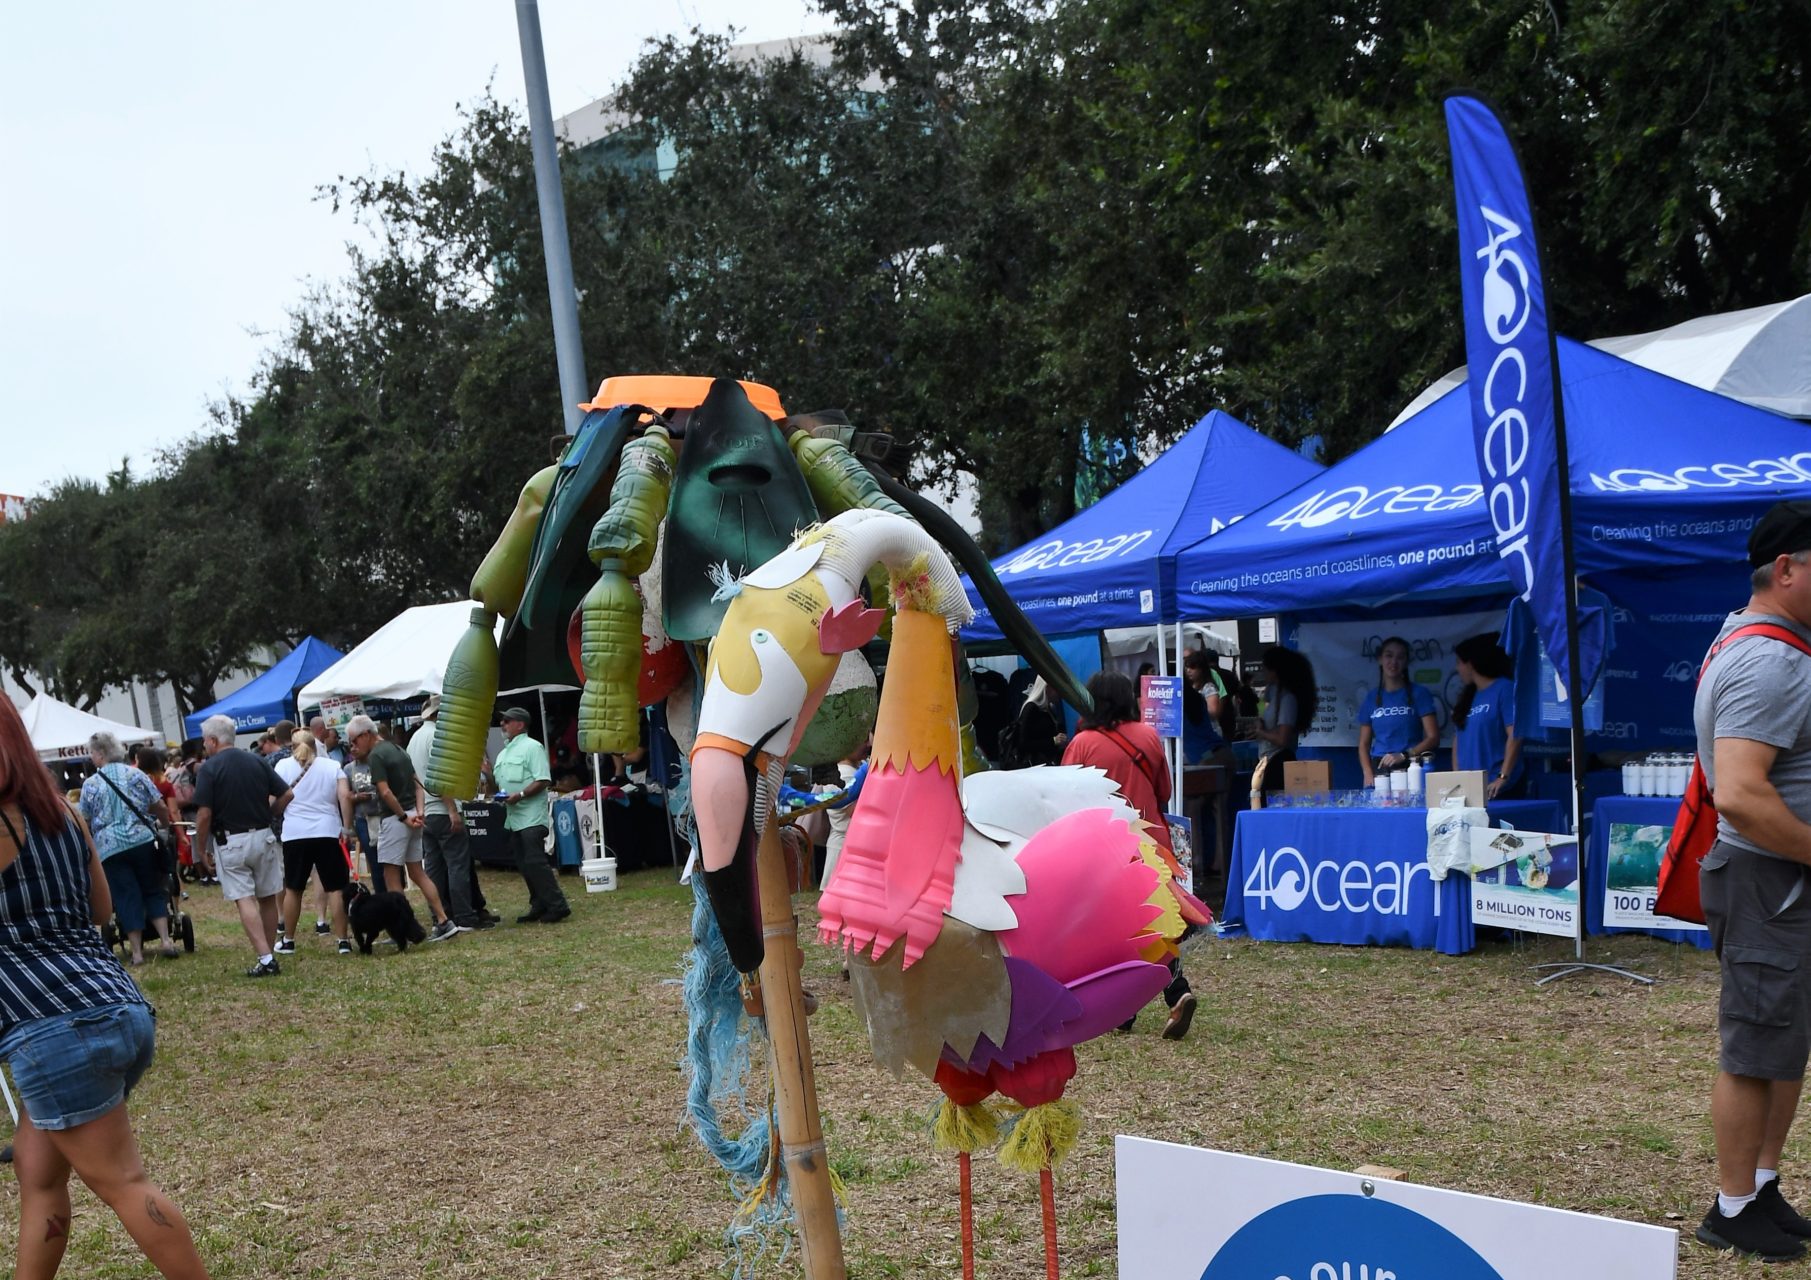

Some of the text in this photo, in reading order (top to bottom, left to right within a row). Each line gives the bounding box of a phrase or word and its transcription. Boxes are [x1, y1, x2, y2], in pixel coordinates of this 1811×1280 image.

[1592, 514, 1754, 541] Cleaning the oceans and
[1190, 577, 1239, 595] Cleaning
[1241, 573, 1259, 587] the
[1261, 566, 1303, 584] oceans
[1305, 560, 1329, 578] and
[1331, 554, 1396, 574] coastlines,
[1398, 551, 1425, 566] one
[1427, 540, 1475, 565] pound
[1057, 597, 1073, 607] one
[1073, 589, 1099, 608] pound
[1099, 591, 1107, 602] at
[1108, 593, 1114, 601] a
[1476, 899, 1483, 910] 8
[1486, 900, 1536, 917] MILLION
[1538, 907, 1572, 922] TONS
[1613, 896, 1641, 911] 100
